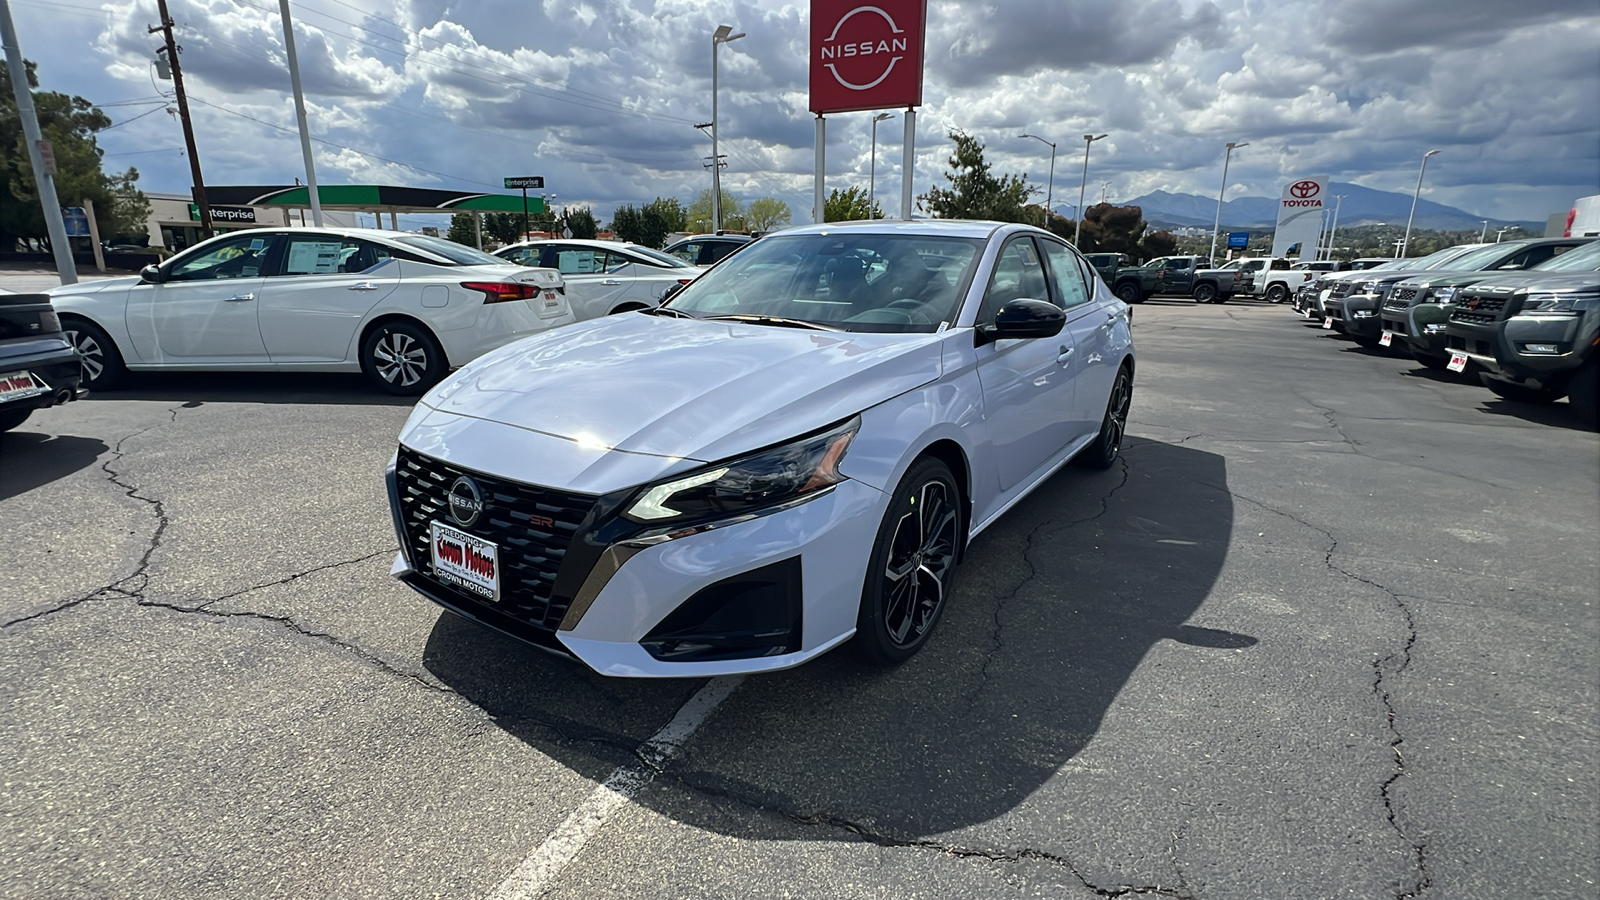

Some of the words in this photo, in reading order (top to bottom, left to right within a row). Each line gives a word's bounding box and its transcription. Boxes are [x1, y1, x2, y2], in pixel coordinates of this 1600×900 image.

[821, 37, 907, 60] NISSAN
[506, 179, 539, 187] enterprise
[1282, 199, 1322, 208] TOYOTA
[448, 493, 483, 511] NISSAN
[530, 514, 554, 528] SR
[445, 528, 479, 547] REDDING
[436, 534, 463, 567] Crown
[465, 542, 495, 580] Motors
[436, 568, 462, 585] CROWN
[462, 579, 494, 598] MOTORS
